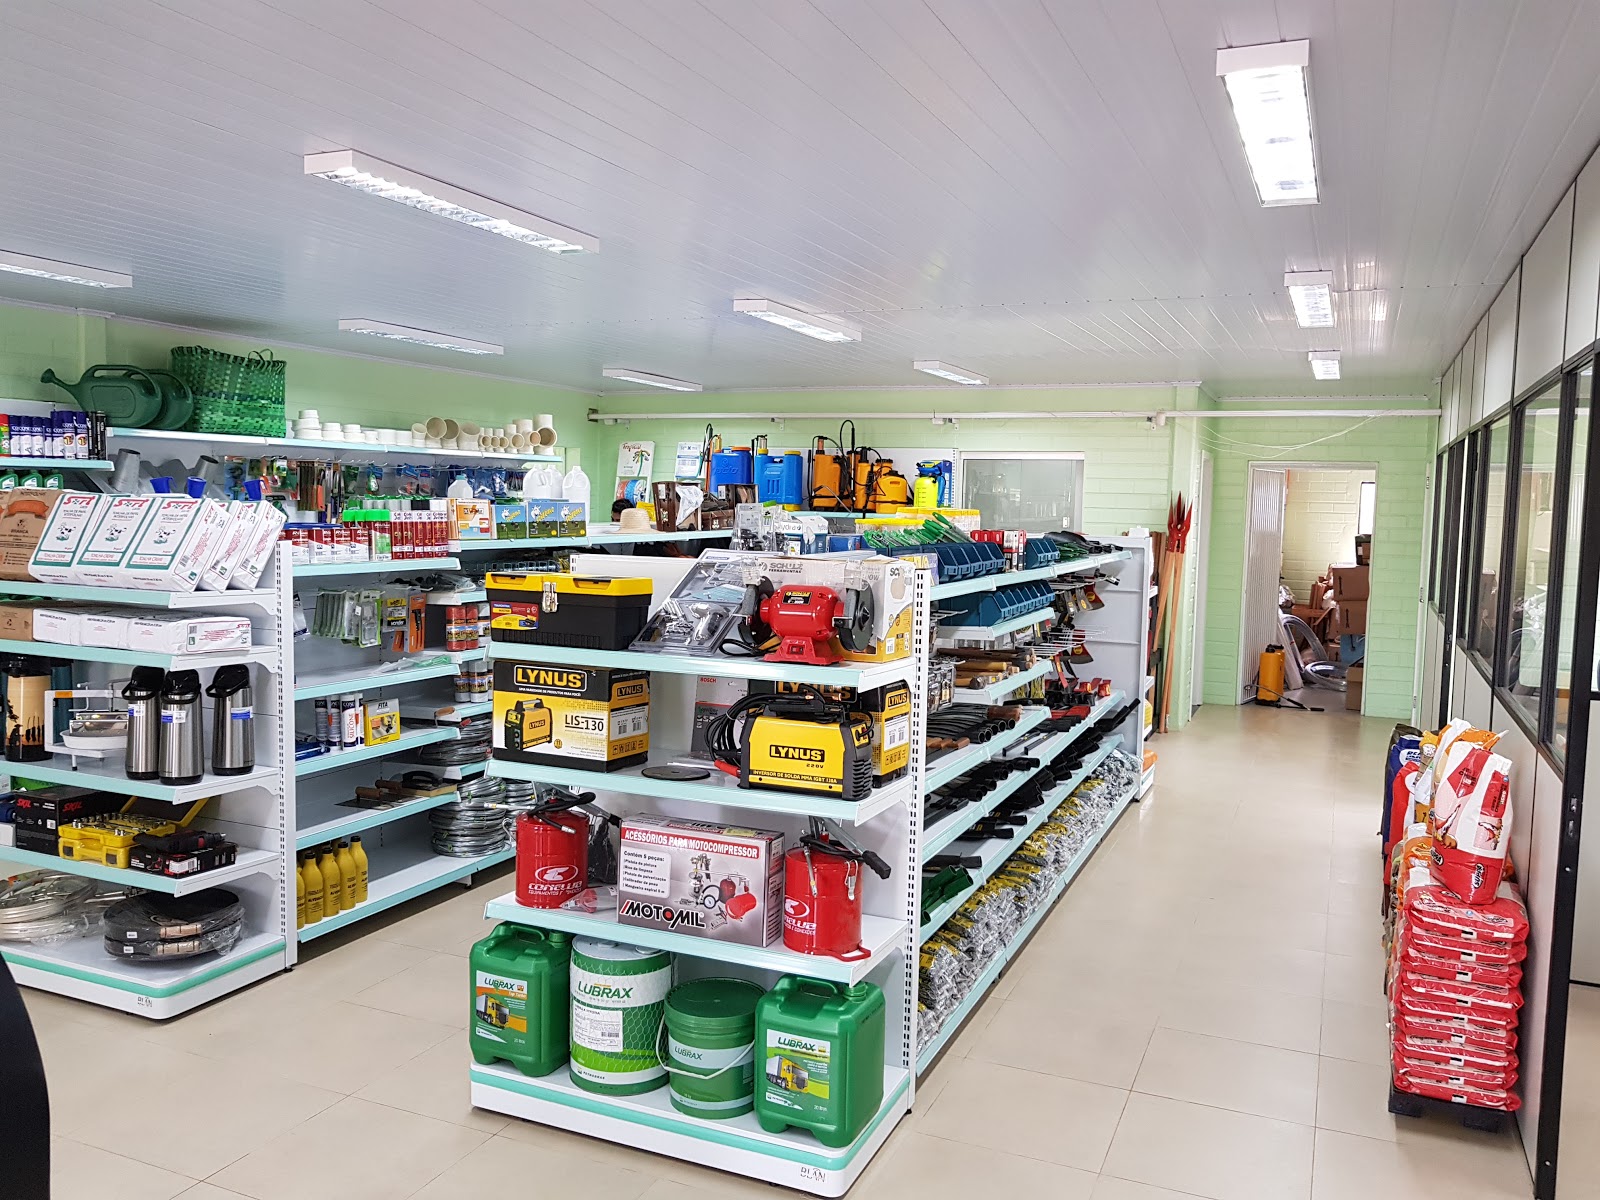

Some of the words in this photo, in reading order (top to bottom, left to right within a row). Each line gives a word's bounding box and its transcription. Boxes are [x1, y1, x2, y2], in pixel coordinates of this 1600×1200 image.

[516, 667, 583, 688] LYNUS
[617, 685, 642, 696] LYNUS
[888, 694, 907, 707] LYNUS
[529, 720, 545, 729] LYNUS
[565, 714, 604, 732] LIS-130
[770, 746, 822, 761] LYNUS
[624, 830, 667, 846] ACESSÓRIOS
[668, 836, 688, 847] PARA
[689, 839, 758, 858] MOTOCOMPRESSOR
[620, 899, 706, 930] MOTOMIL
[484, 977, 515, 991] LUBRAX
[577, 980, 634, 999] LUBRAX
[778, 1036, 816, 1052] LUBRAX
[674, 1045, 703, 1061] LUBRAX
